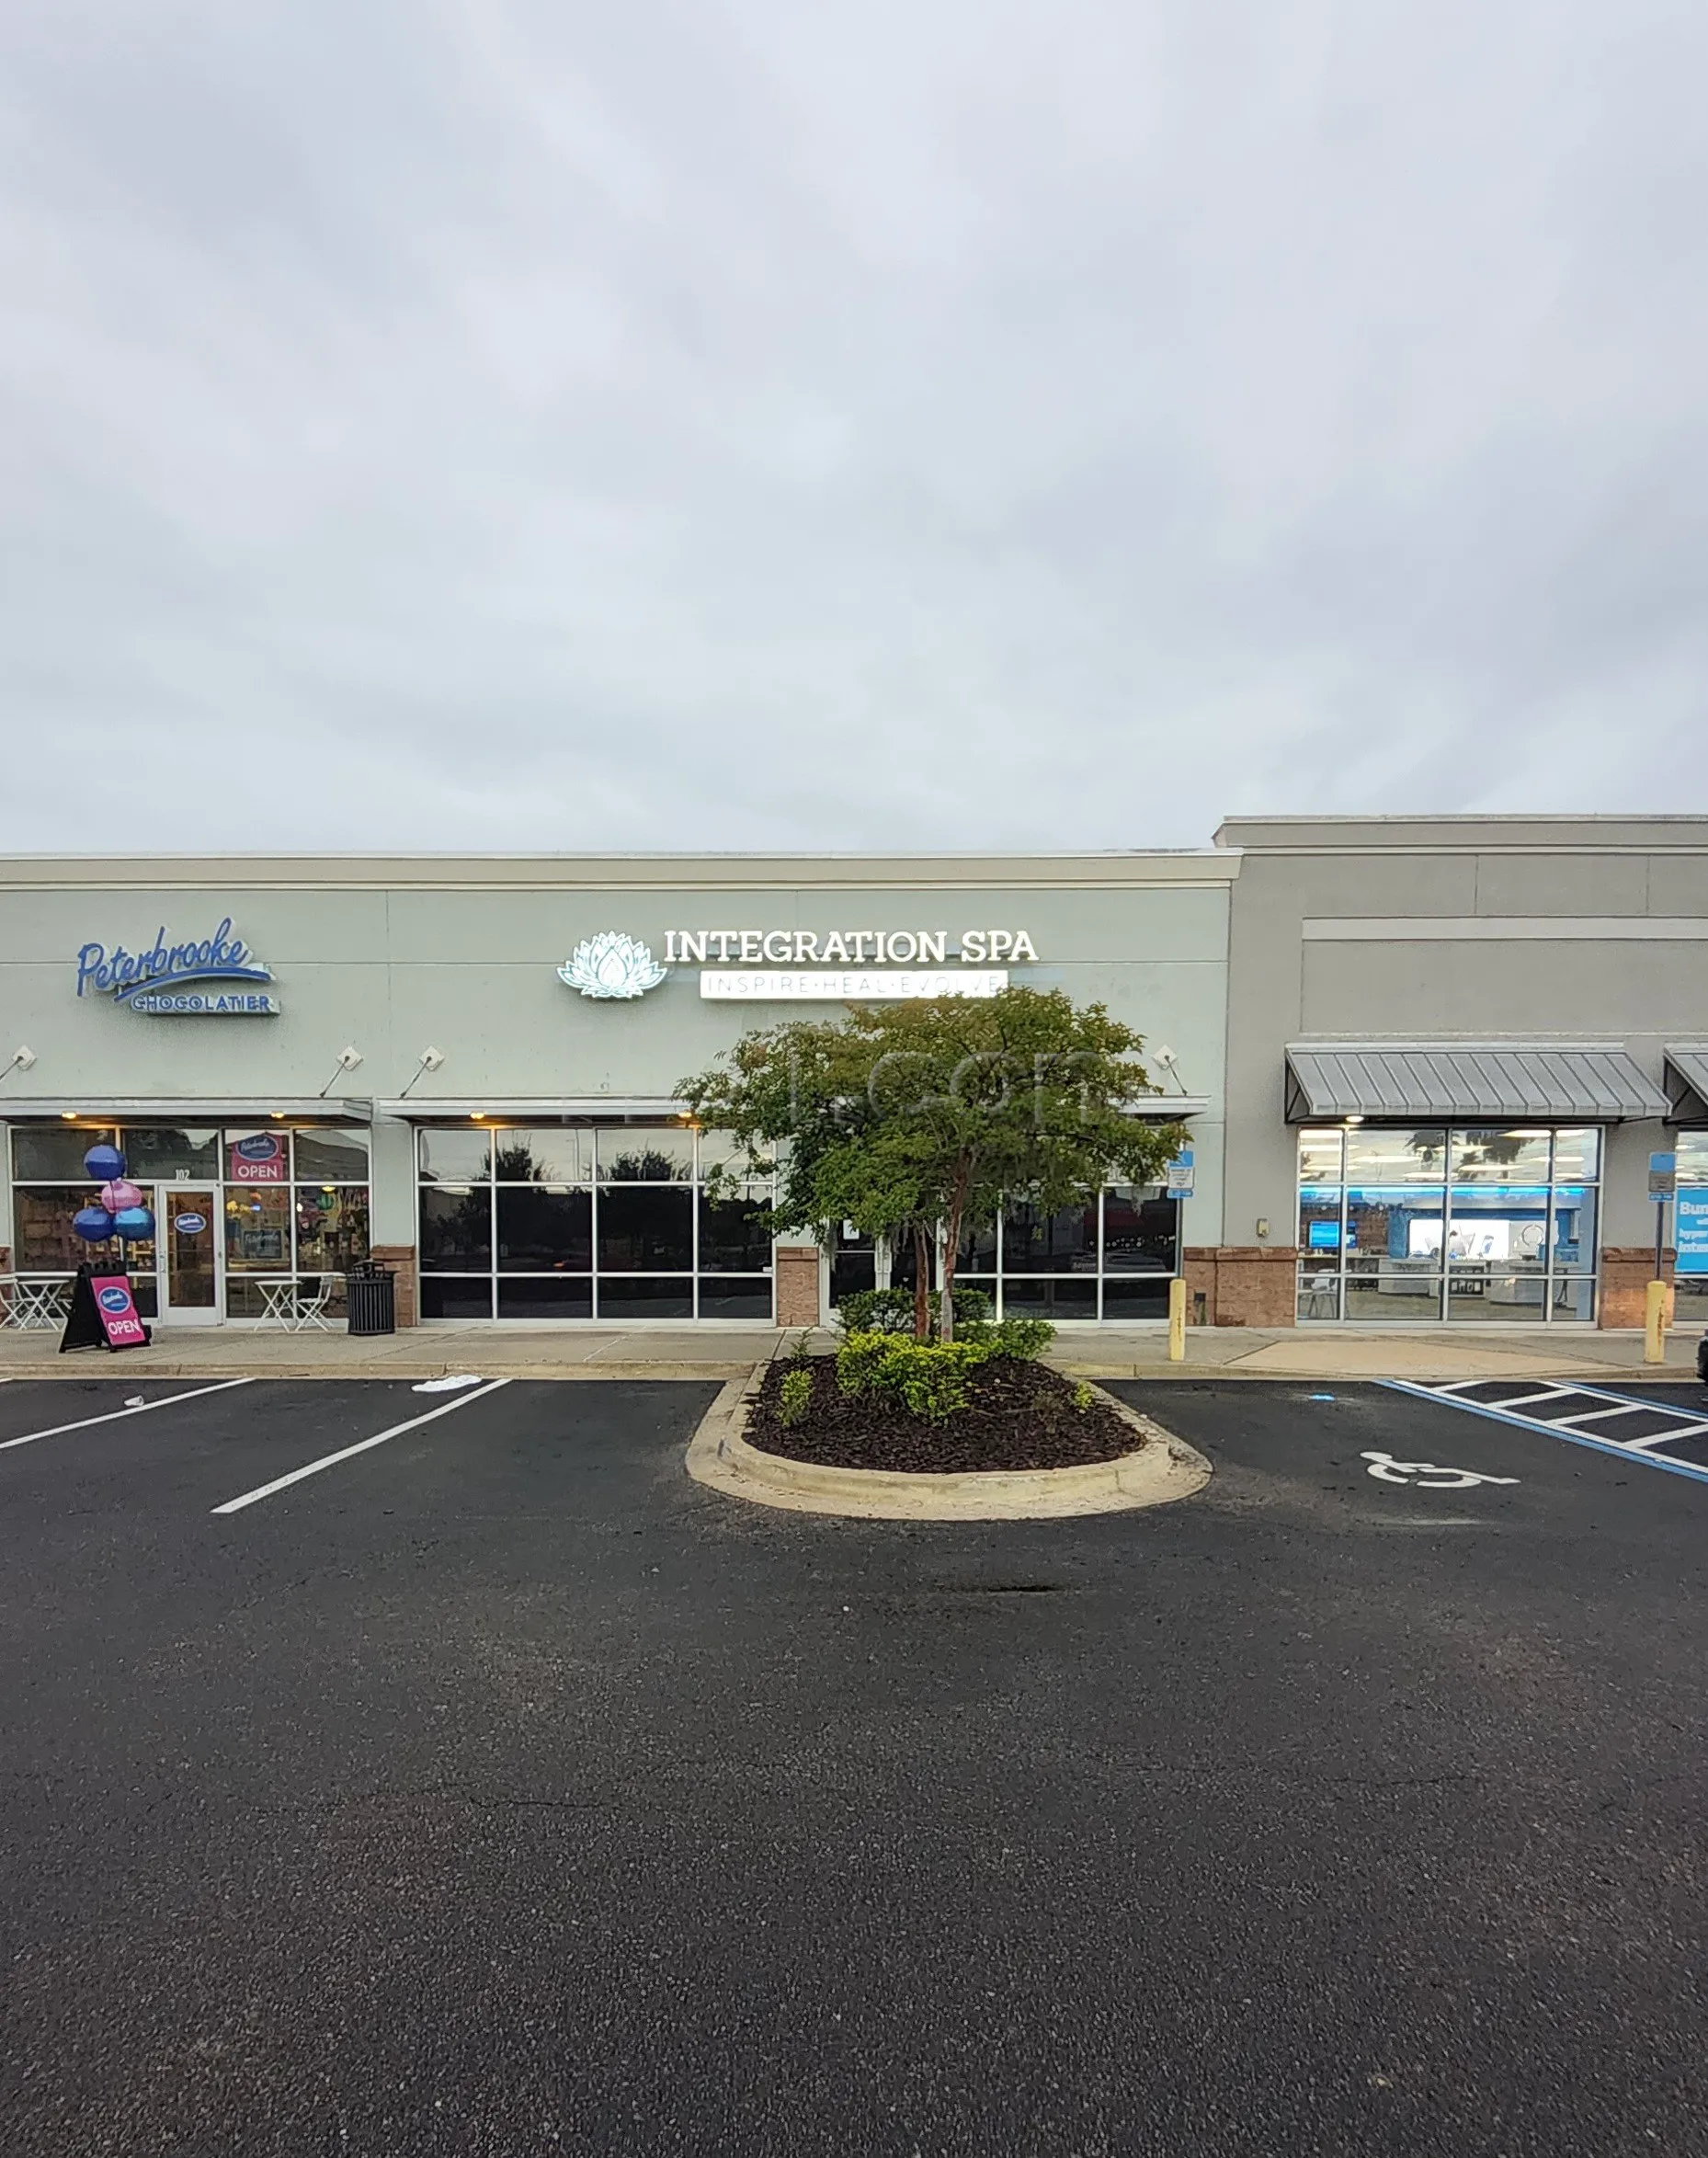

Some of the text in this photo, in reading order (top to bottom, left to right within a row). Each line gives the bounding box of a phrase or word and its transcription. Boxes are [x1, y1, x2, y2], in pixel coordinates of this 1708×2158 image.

[664, 930, 1040, 963] INTEGRATION SPA
[77, 917, 251, 998] Peterbrooke
[131, 995, 270, 1010] CHOCOLATIER
[175, 1169, 190, 1181] 102
[237, 1164, 278, 1178] OPEN
[108, 1319, 141, 1335] OPEN
